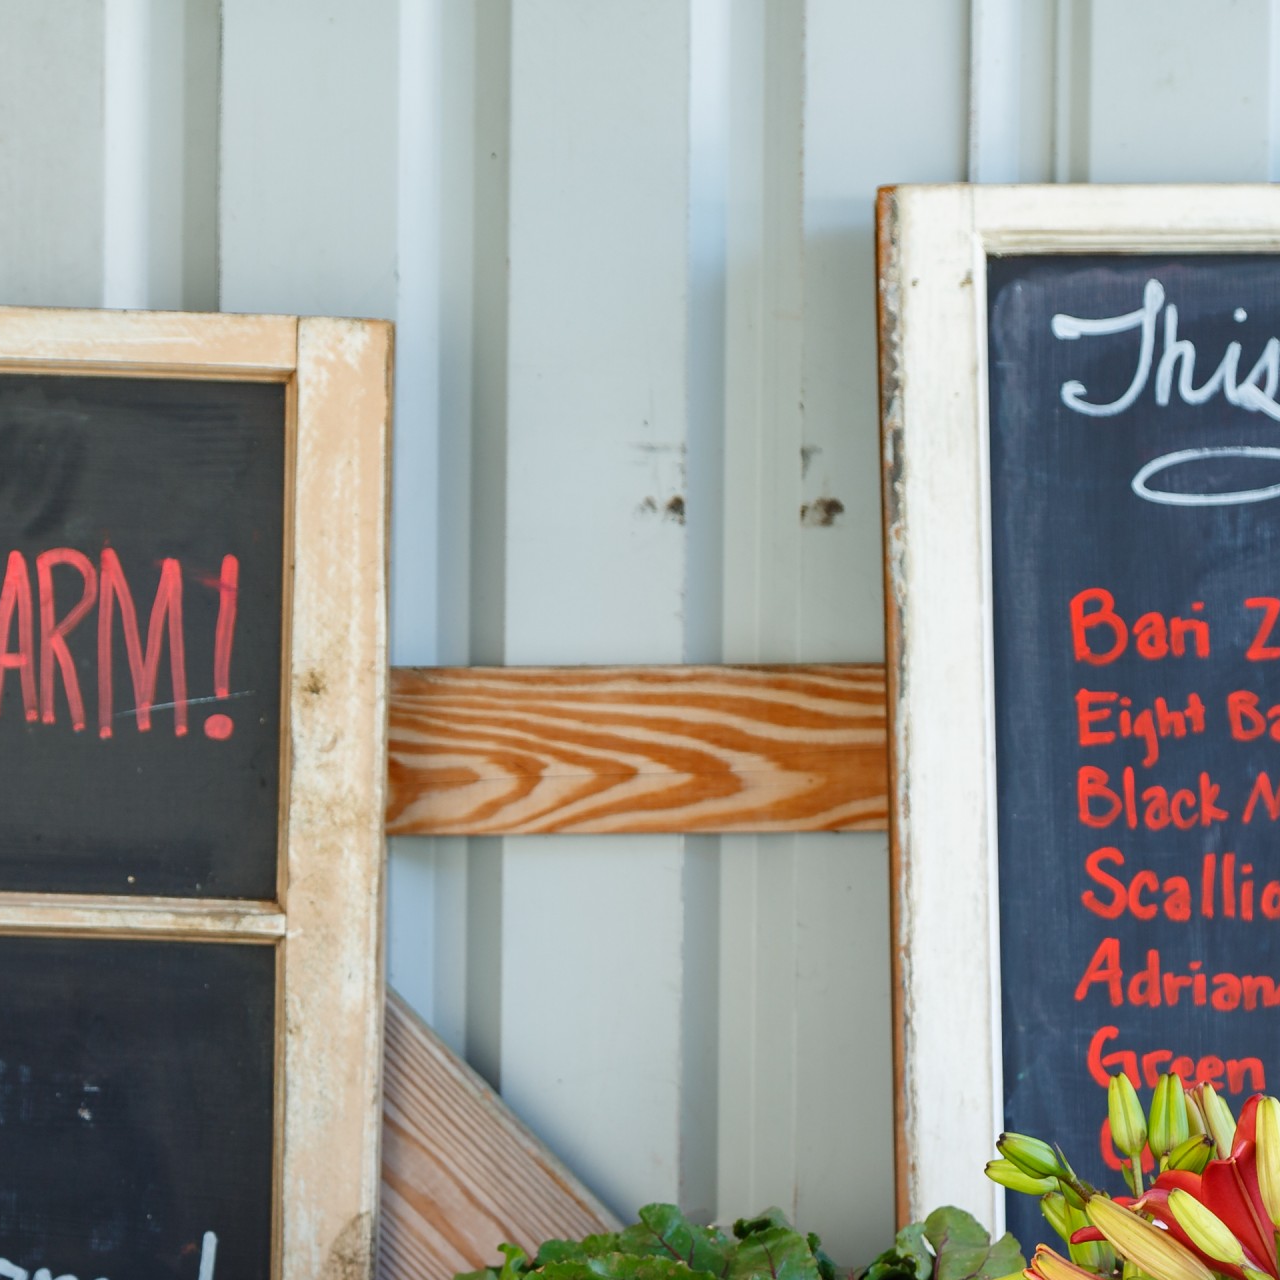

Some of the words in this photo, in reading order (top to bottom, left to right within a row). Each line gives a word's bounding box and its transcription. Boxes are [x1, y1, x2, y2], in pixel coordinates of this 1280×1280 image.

[1069, 588, 1210, 665] Bari
[1075, 688, 1205, 767] Eight
[1077, 766, 1228, 830] Black
[1087, 1025, 1266, 1095] Green
